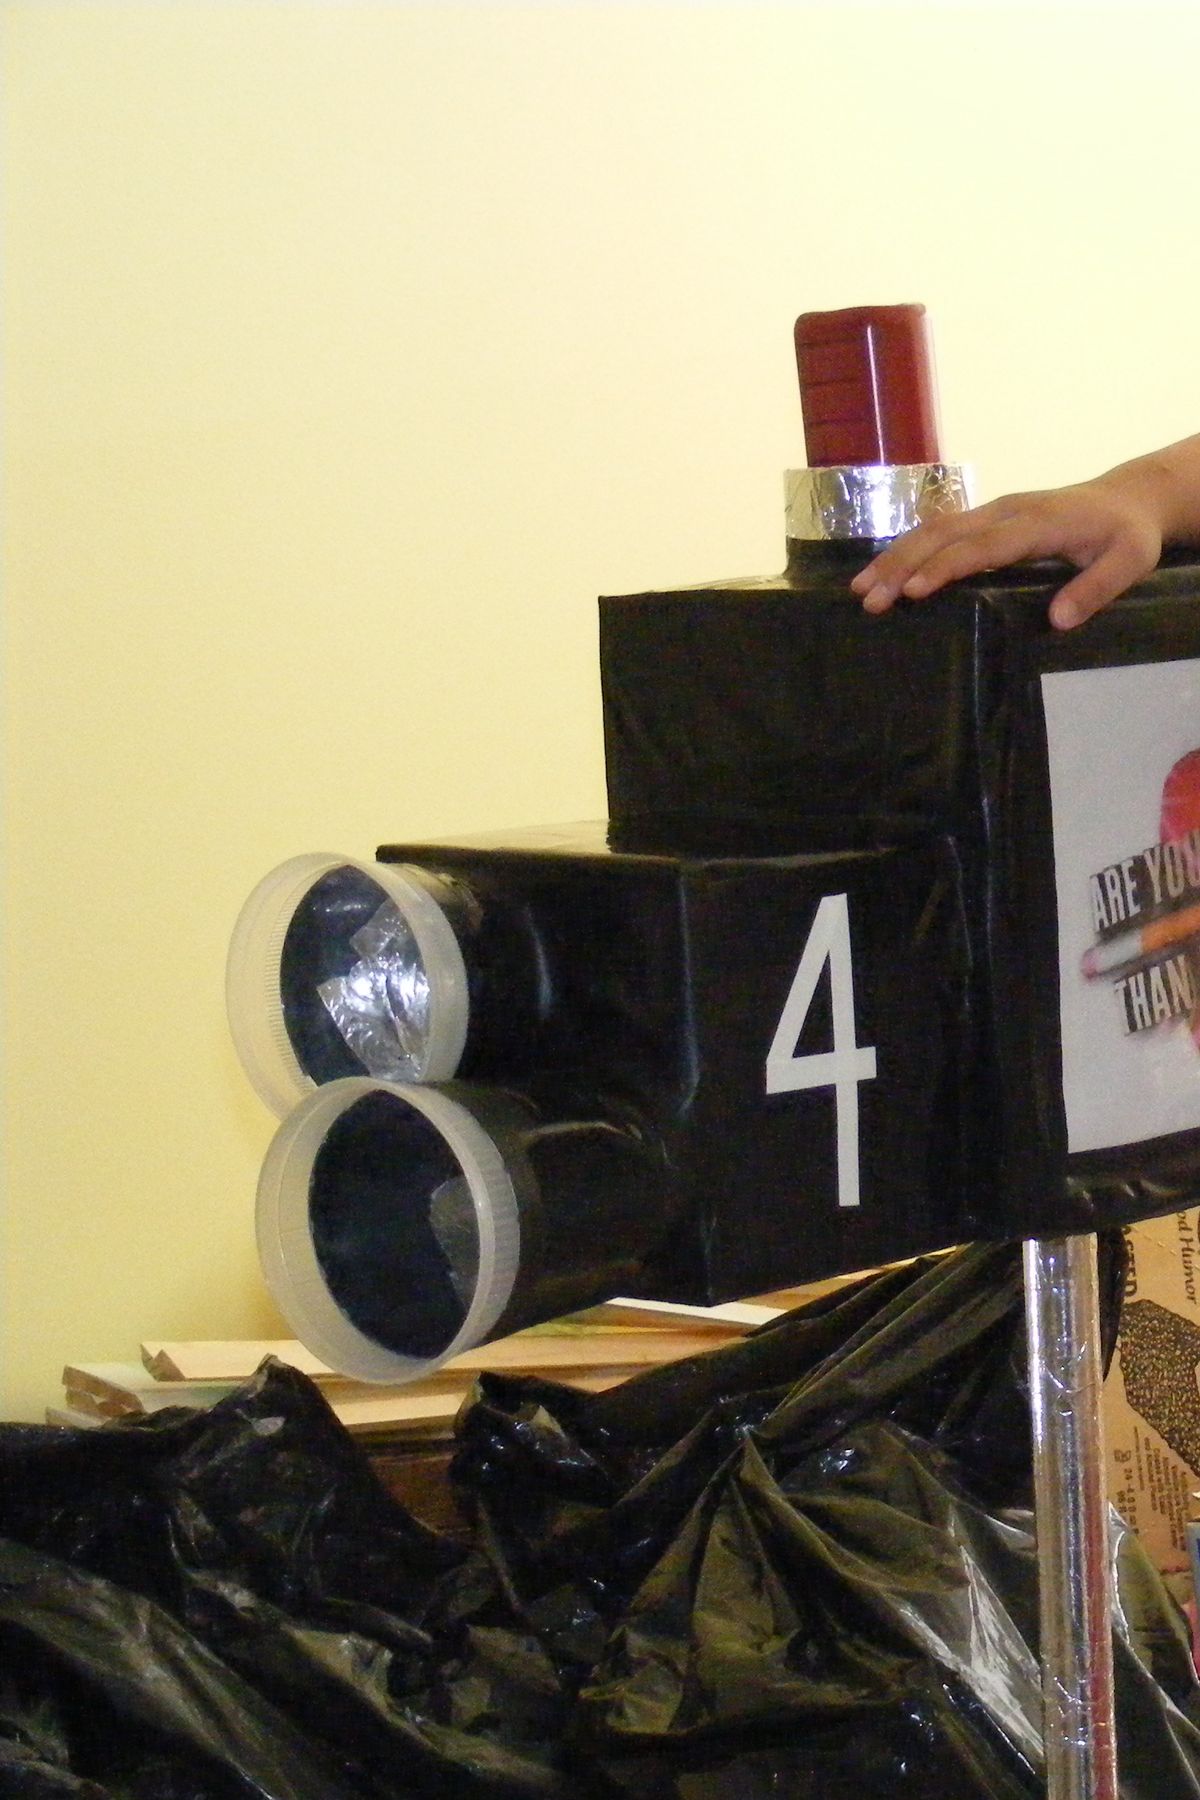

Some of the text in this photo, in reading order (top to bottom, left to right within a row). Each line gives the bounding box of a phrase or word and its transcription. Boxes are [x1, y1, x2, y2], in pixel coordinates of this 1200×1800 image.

[1089, 858, 1142, 935] ARE
[1114, 954, 1194, 1036] THAN
[766, 893, 877, 1206] 4
[1179, 1237, 1198, 1305] Humor
